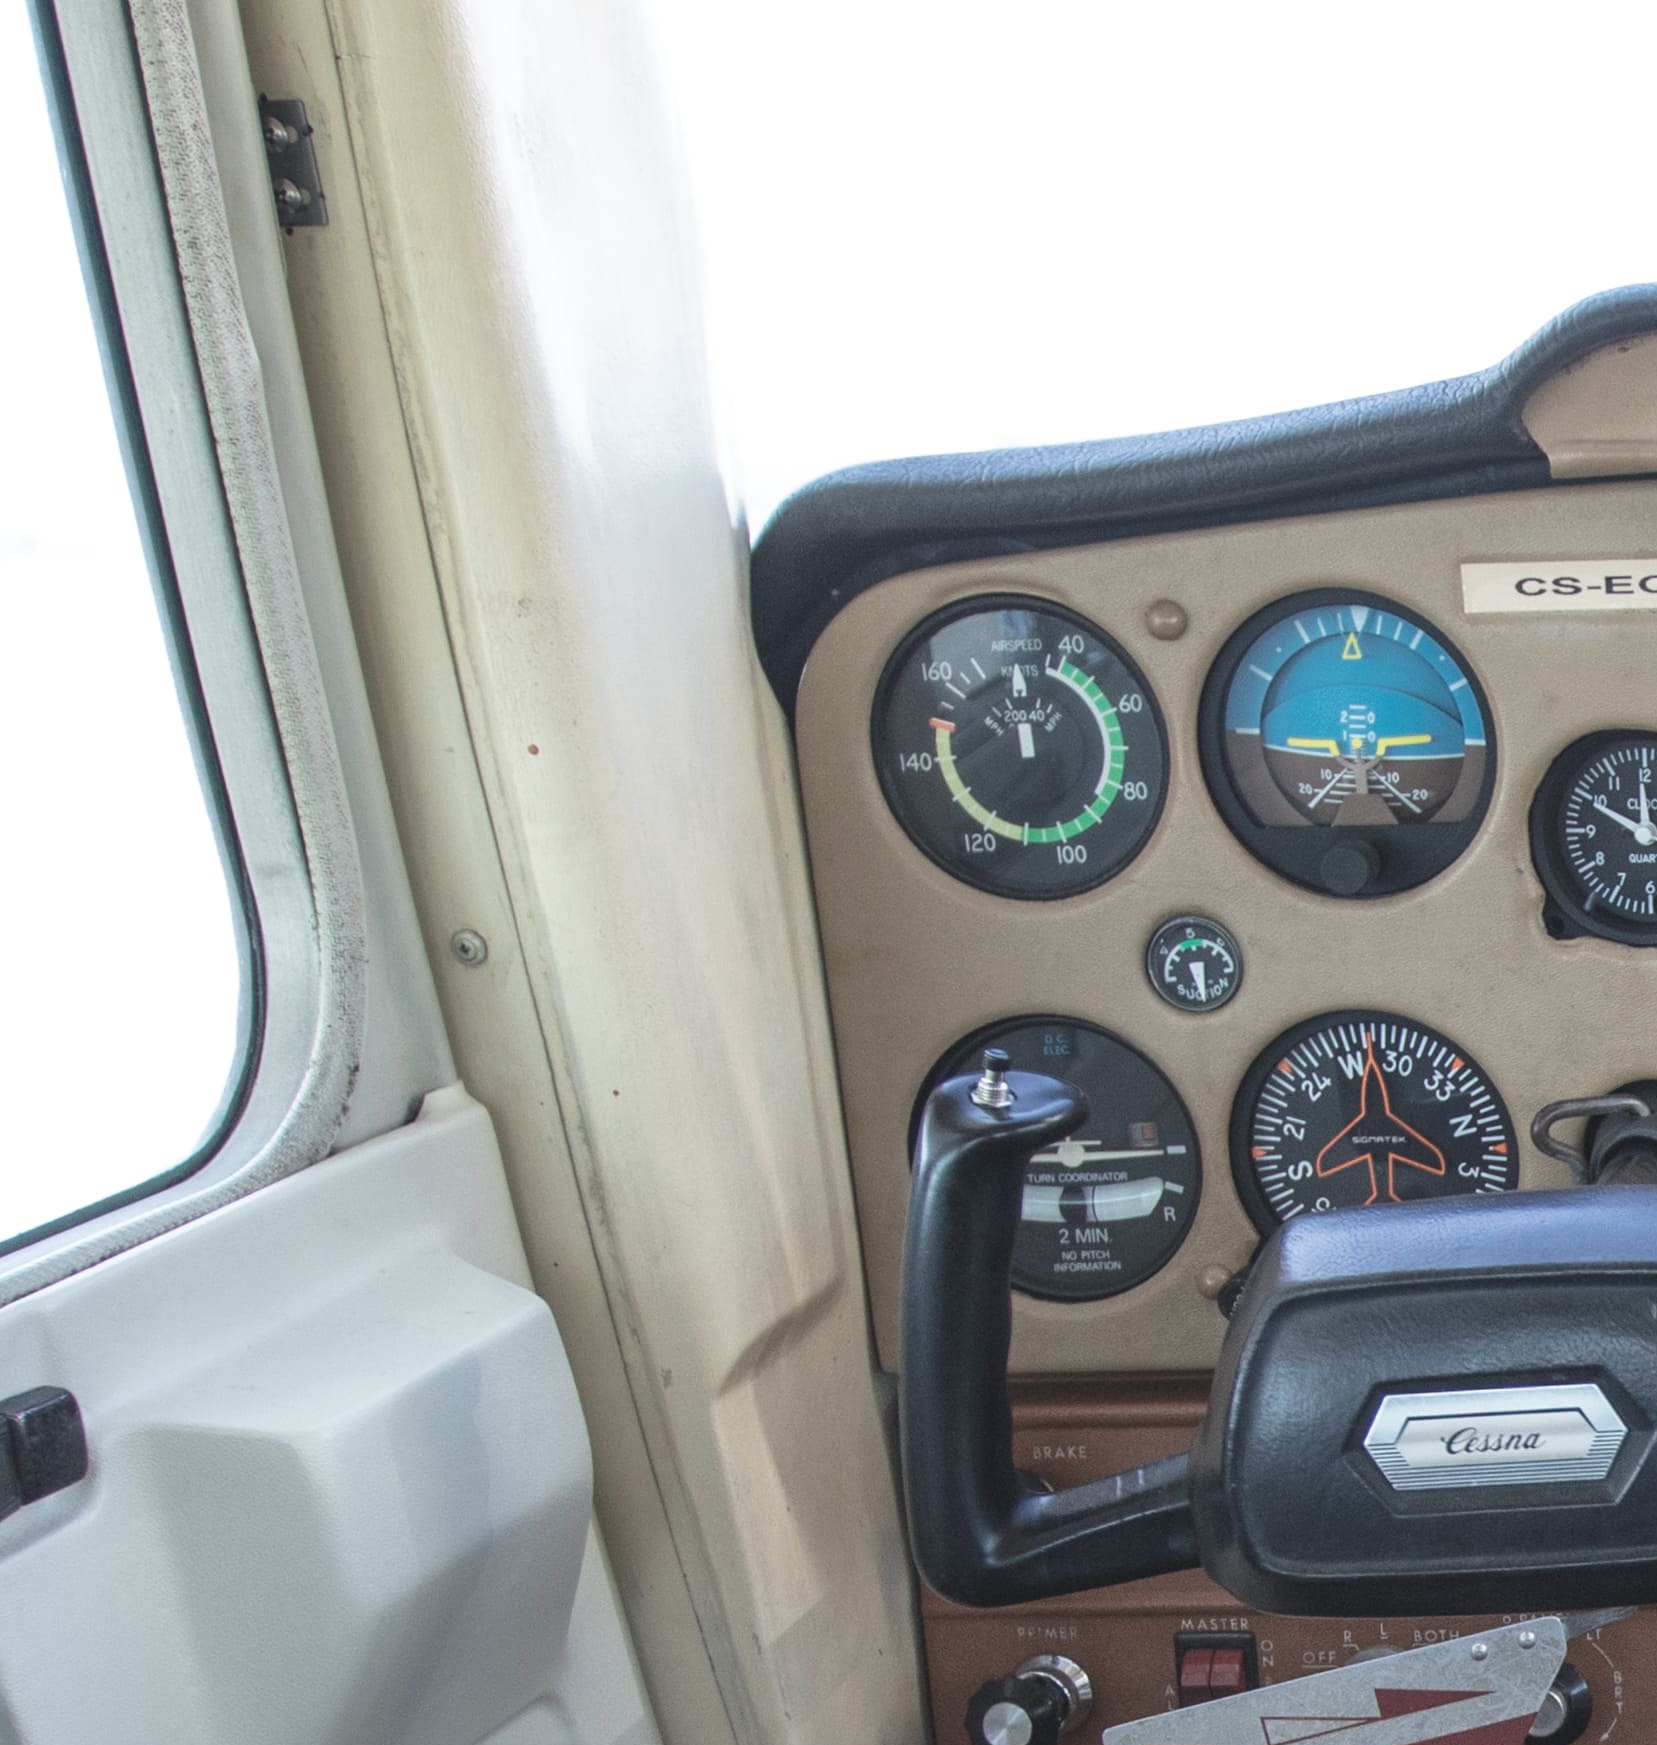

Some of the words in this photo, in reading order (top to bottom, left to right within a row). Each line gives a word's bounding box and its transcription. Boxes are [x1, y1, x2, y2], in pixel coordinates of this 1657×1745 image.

[991, 639, 1042, 651] AIRSPEED
[1058, 635, 1084, 653] 40
[921, 662, 951, 680] 160
[1118, 695, 1143, 713] 60
[900, 753, 932, 771] 140
[1639, 768, 1652, 783] 12
[1124, 782, 1148, 800] 80
[965, 834, 996, 853] 120
[1057, 845, 1087, 864] 100
[1382, 1051, 1413, 1076] 30
[1302, 1072, 1332, 1102] 24
[1424, 1070, 1455, 1101] 33
[1352, 1136, 1405, 1144] SIGMATEK
[1028, 1173, 1055, 1183] TURN
[1058, 1171, 1127, 1182] COORDINATOR
[1059, 1229, 1070, 1244] 2
[1075, 1228, 1112, 1243] MIN.
[1062, 1251, 1076, 1260] NO
[1081, 1250, 1109, 1259] PITCH
[1054, 1261, 1121, 1271] INFORMATION
[1441, 1427, 1544, 1455] Cessna
[1032, 1444, 1088, 1461] BRAKE
[1181, 1619, 1249, 1631] MASTER
[1302, 1651, 1338, 1667] OFF
